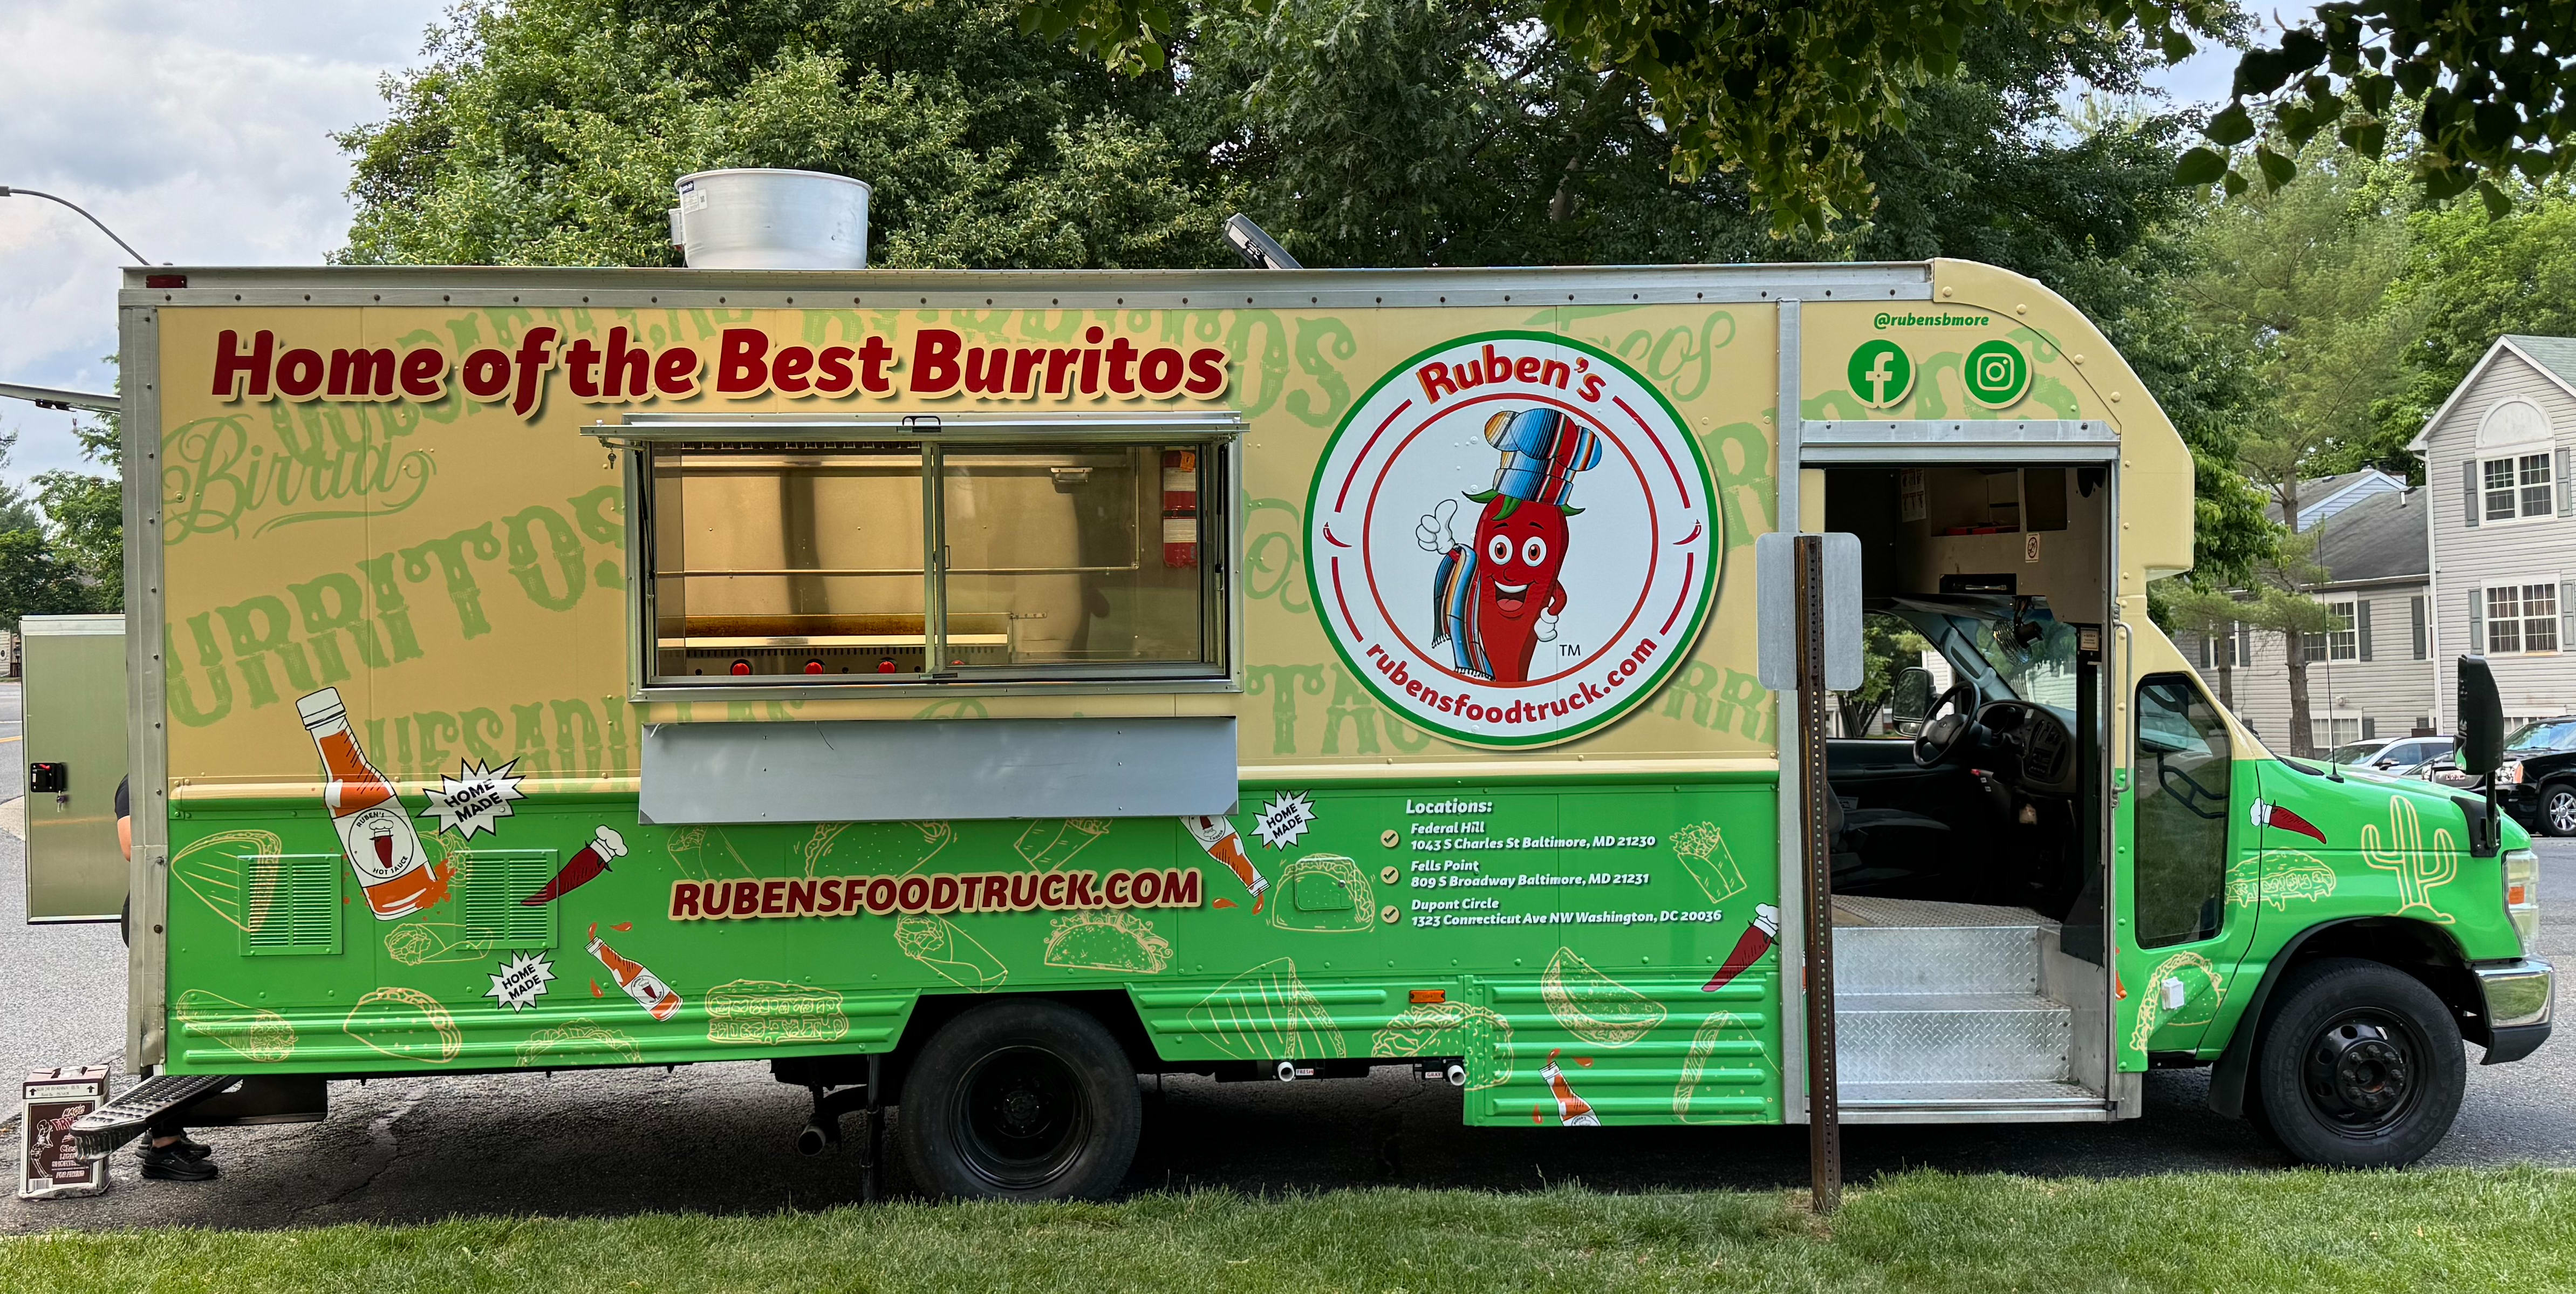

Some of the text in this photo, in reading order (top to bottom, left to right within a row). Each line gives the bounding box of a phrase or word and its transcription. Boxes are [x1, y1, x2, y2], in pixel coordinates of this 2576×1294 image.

[1874, 312, 1989, 330] @rubensbmore
[211, 329, 444, 396] Home
[462, 326, 558, 417] of
[565, 326, 698, 397] the
[716, 328, 893, 393] Best
[910, 326, 1225, 394] Burritos
[1415, 344, 1607, 405] Ruben's
[1559, 644, 1581, 656] TM
[1366, 638, 1658, 724] rubensfoodtruck.com
[443, 779, 495, 808] HOME
[454, 792, 503, 823] MADE
[1406, 798, 1493, 814] Locations:
[356, 812, 385, 827] RUBEN'S
[1266, 803, 1298, 829] HOME
[1272, 814, 1303, 839] MADE
[1411, 821, 1485, 834] Federal Hill
[1411, 836, 1656, 851] 1043 S Charles St Baltimore, MD 21230
[391, 855, 408, 874] SAUCE
[1411, 859, 1479, 871] Fells Point
[1411, 873, 1649, 889] 809 S Broadway Baltimore, MD 21231
[674, 871, 1199, 917] RUBENSFOODTRUCK.COM
[1411, 897, 1499, 912] Dupont Circle
[1411, 909, 1723, 927] 1323 Connecticut Ave NW Washington, DC 20036
[502, 963, 536, 990] HOME
[508, 975, 542, 1000] MADE
